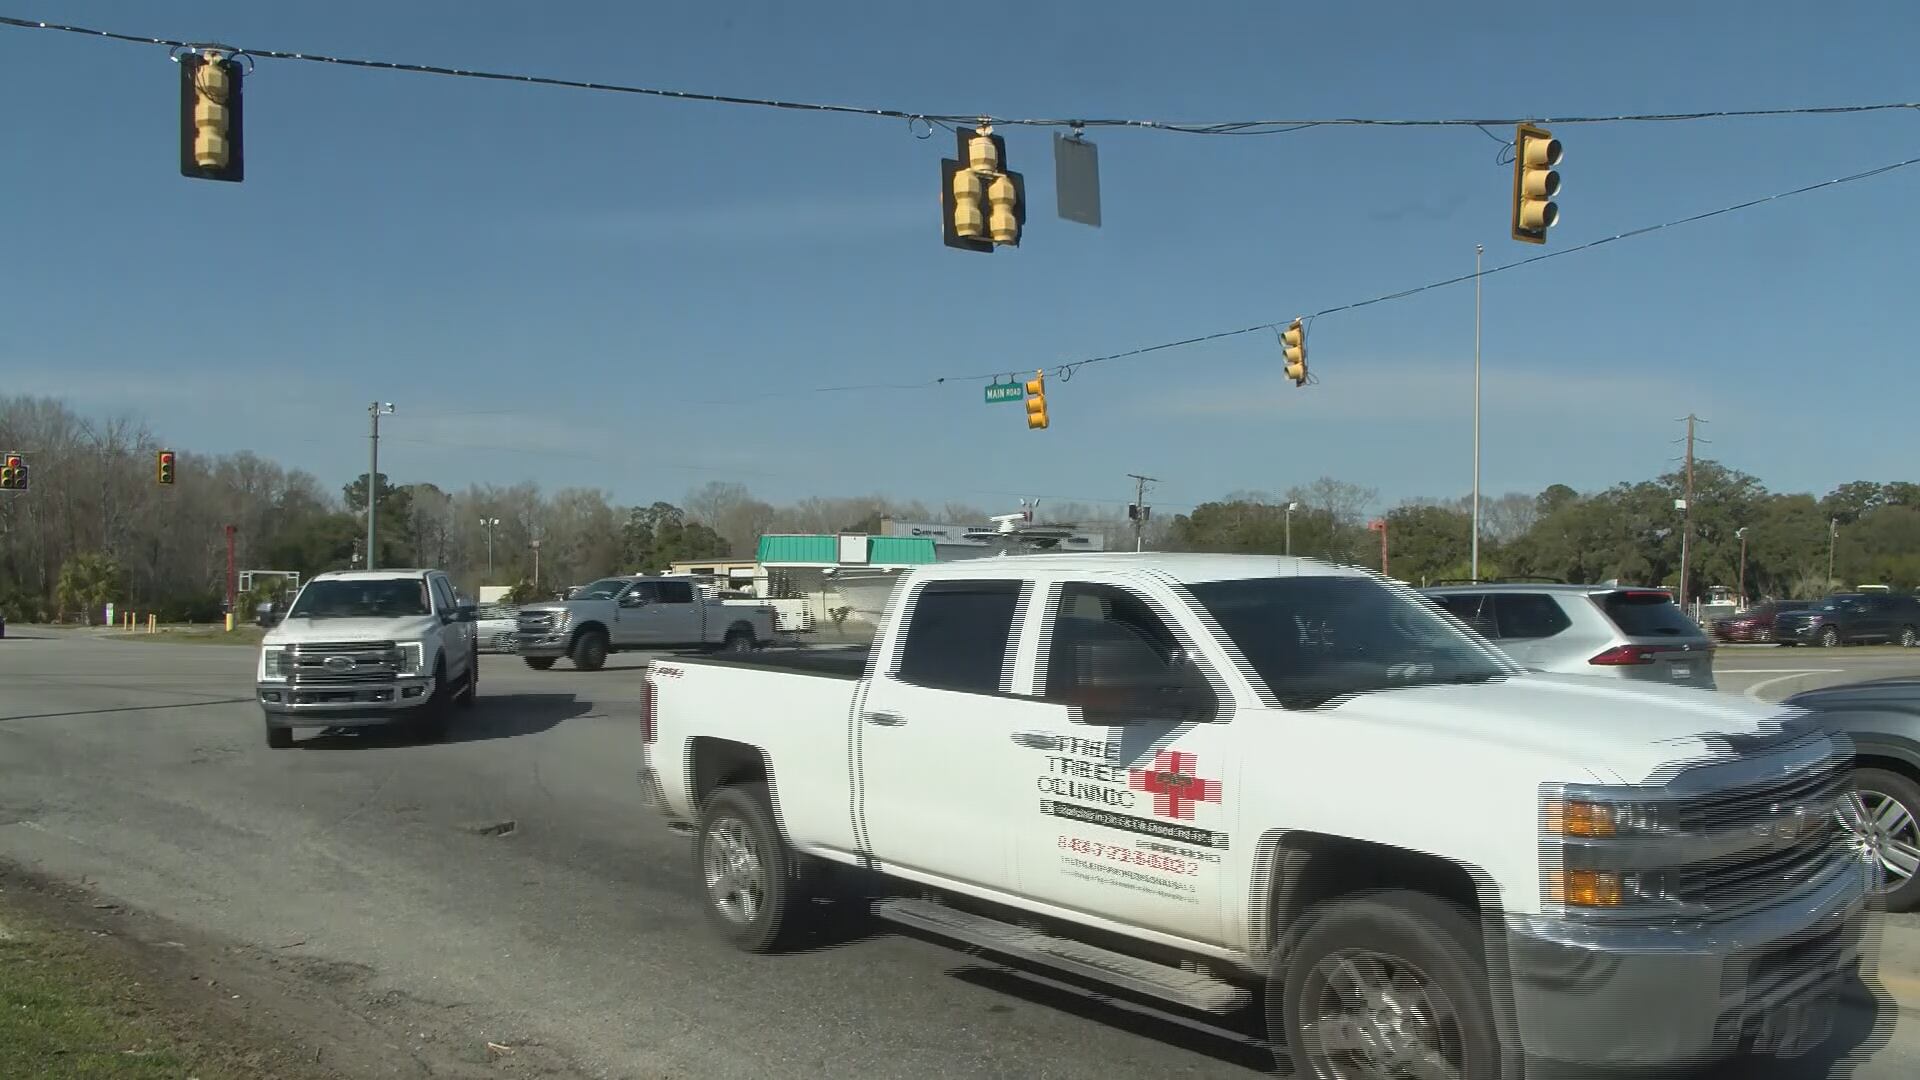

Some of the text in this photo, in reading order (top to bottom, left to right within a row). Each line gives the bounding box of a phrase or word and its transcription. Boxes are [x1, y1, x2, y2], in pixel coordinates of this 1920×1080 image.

[986, 387, 1021, 399] MAIN ROAD
[1056, 735, 1120, 760] THE
[1045, 756, 1127, 785] TREE
[1037, 776, 1135, 808] CLINIC
